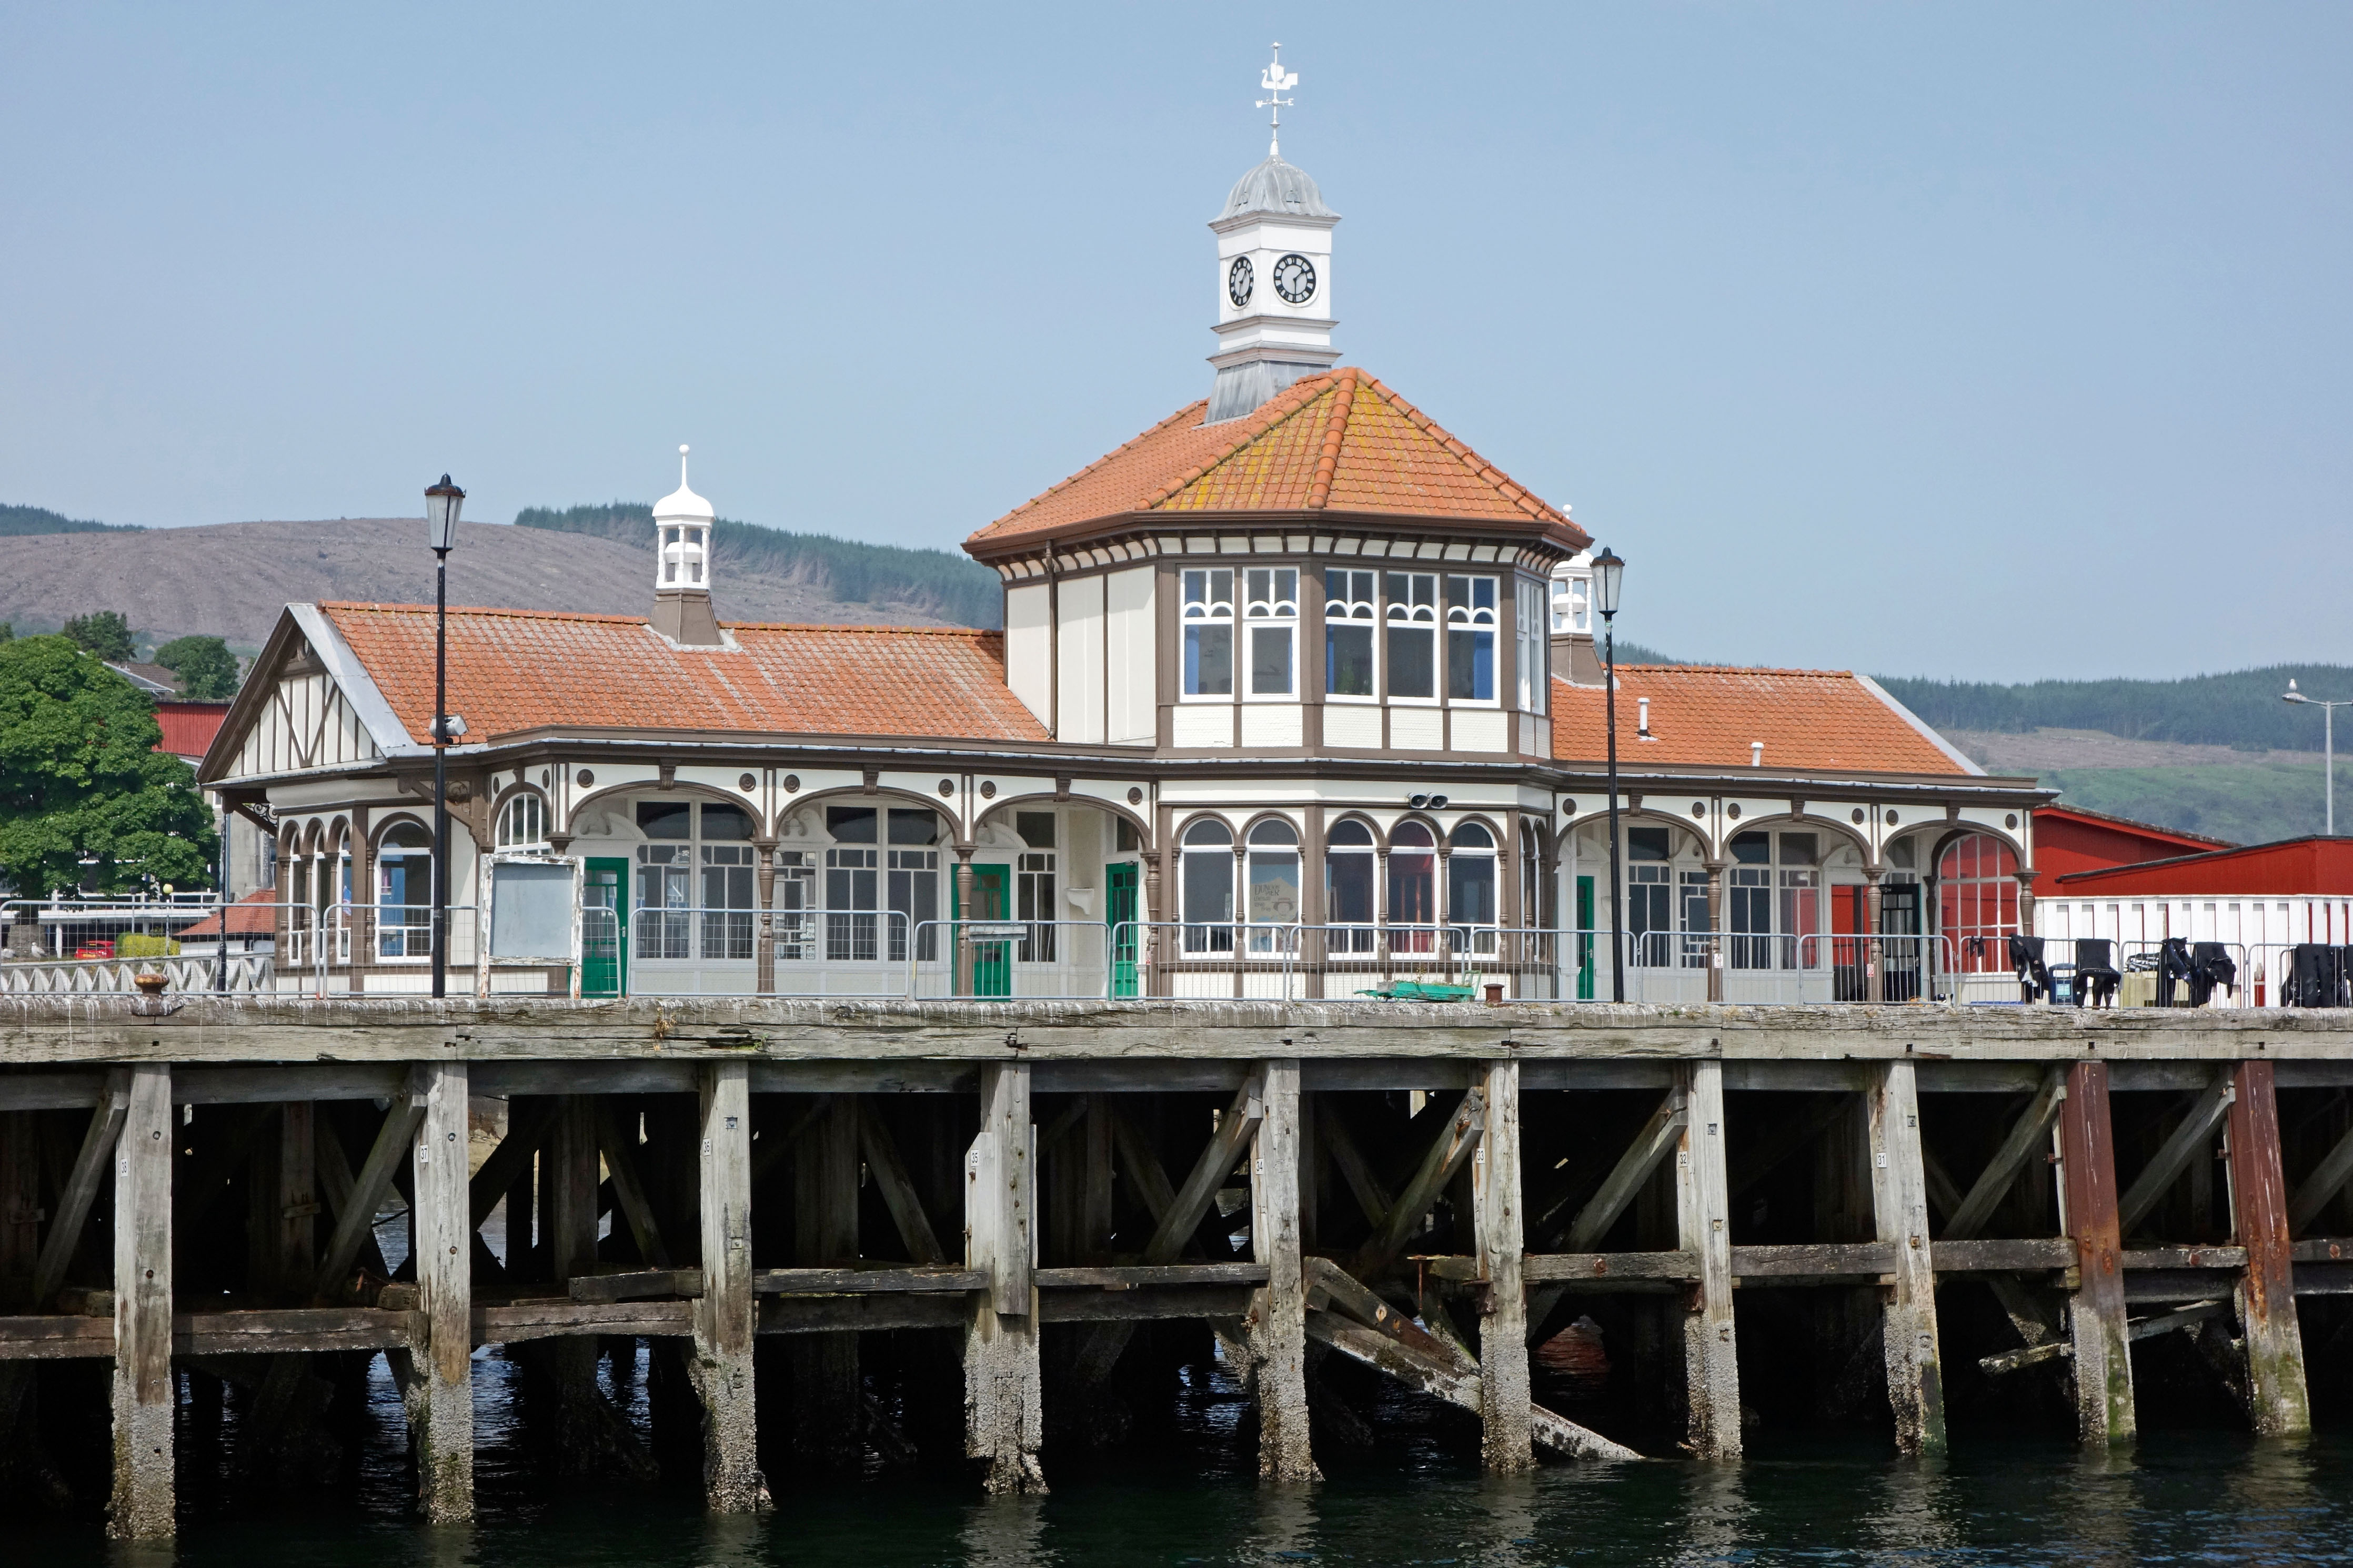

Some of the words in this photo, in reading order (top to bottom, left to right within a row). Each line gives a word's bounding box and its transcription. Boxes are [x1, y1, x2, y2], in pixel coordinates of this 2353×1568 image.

[704, 1141, 709, 1152] 36
[421, 1148, 427, 1159] 37
[972, 1152, 978, 1163] 35
[1477, 1150, 1484, 1161] 33
[1680, 1154, 1687, 1164] 32
[1878, 1155, 1885, 1165] 31
[122, 1161, 127, 1173] 38
[1256, 1161, 1263, 1171] 34
